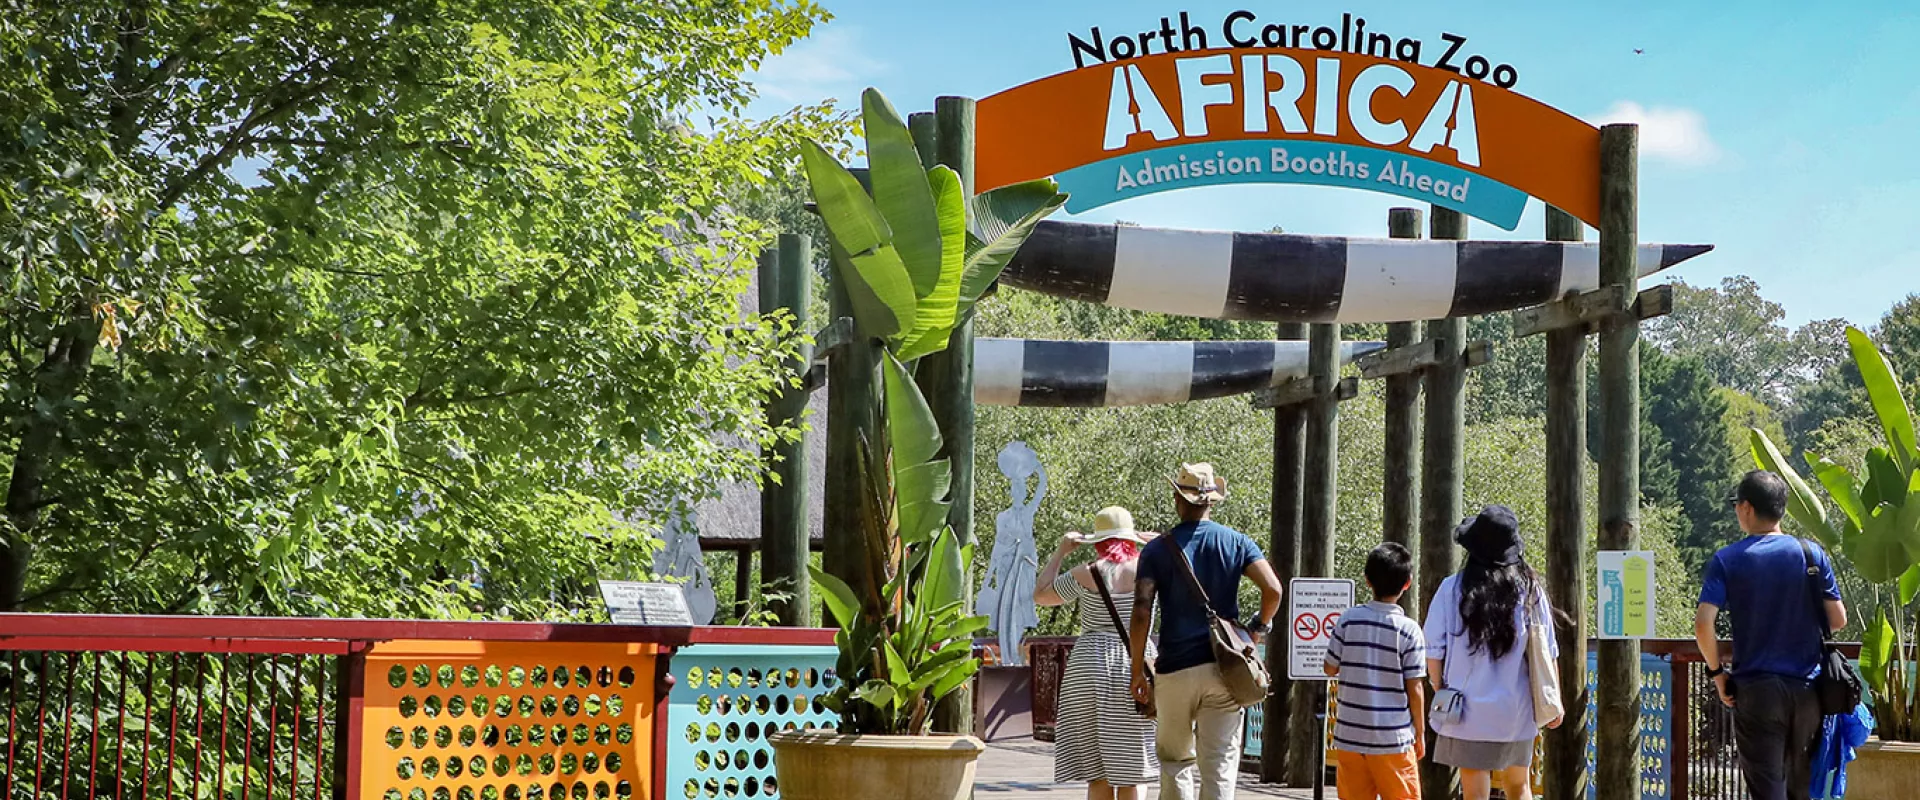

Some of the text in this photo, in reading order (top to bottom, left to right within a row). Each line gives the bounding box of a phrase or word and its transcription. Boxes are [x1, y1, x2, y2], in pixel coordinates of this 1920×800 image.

[1068, 10, 1518, 88] North Carolina Zoo
[1103, 53, 1482, 168] AFRICA
[1115, 148, 1471, 204] Admission Booths Ahead
